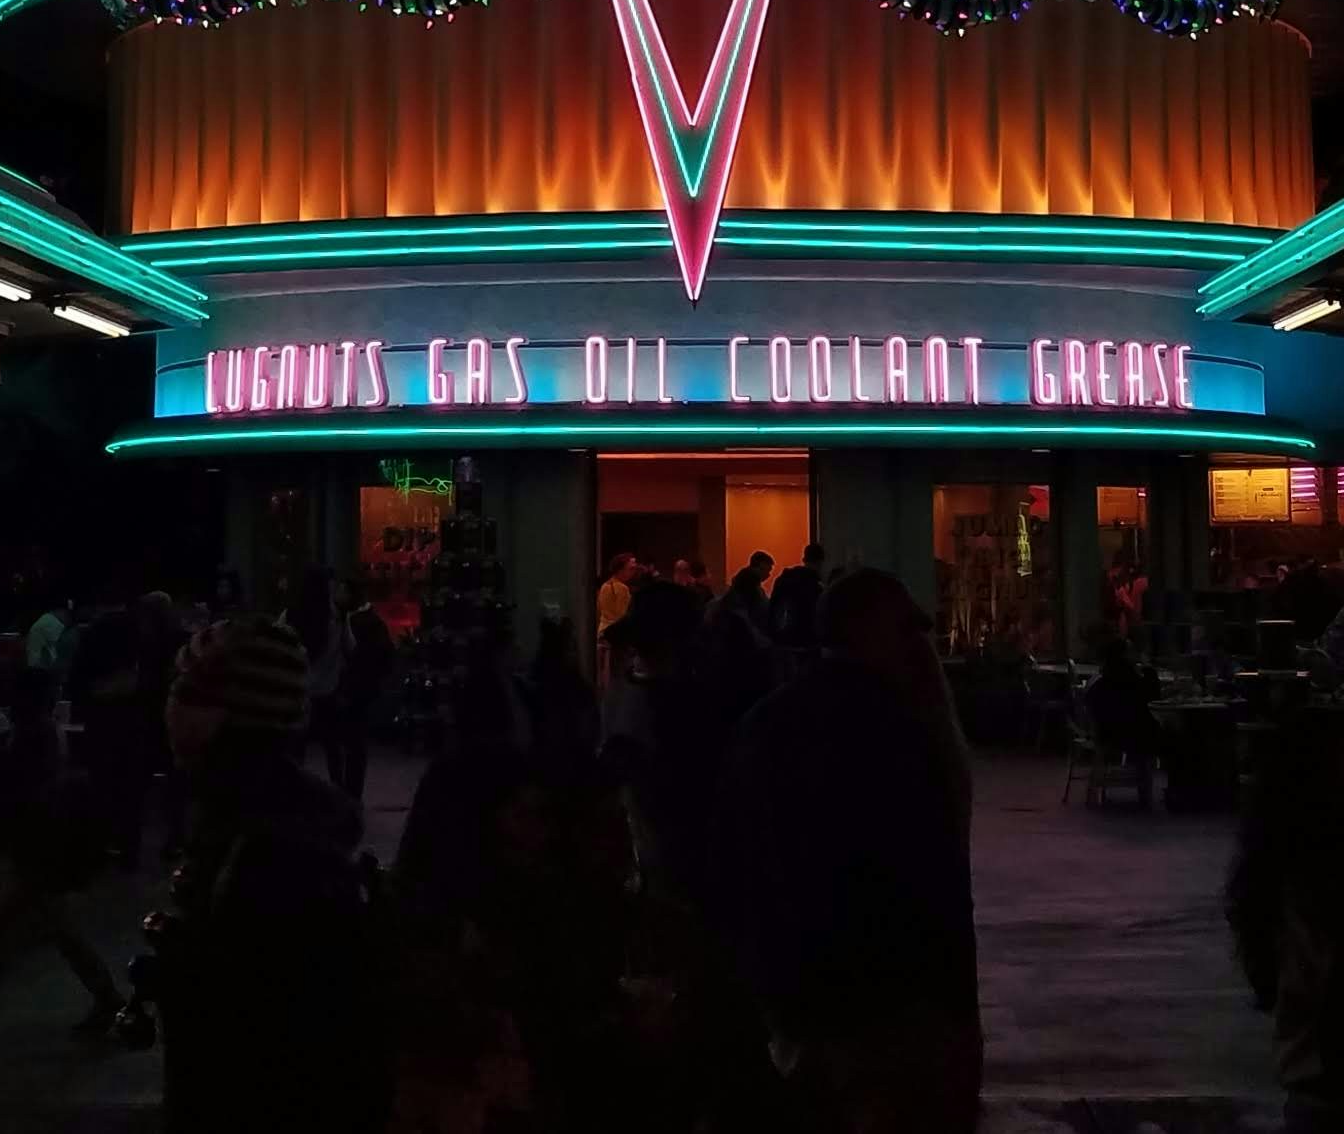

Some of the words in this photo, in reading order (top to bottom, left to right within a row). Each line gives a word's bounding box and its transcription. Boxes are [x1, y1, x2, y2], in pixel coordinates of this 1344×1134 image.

[205, 340, 389, 413] LUGNUTS
[427, 337, 529, 406] GAS
[583, 335, 674, 406] OIL
[728, 334, 983, 406] COOLANT
[1031, 337, 1195, 409] GREASE
